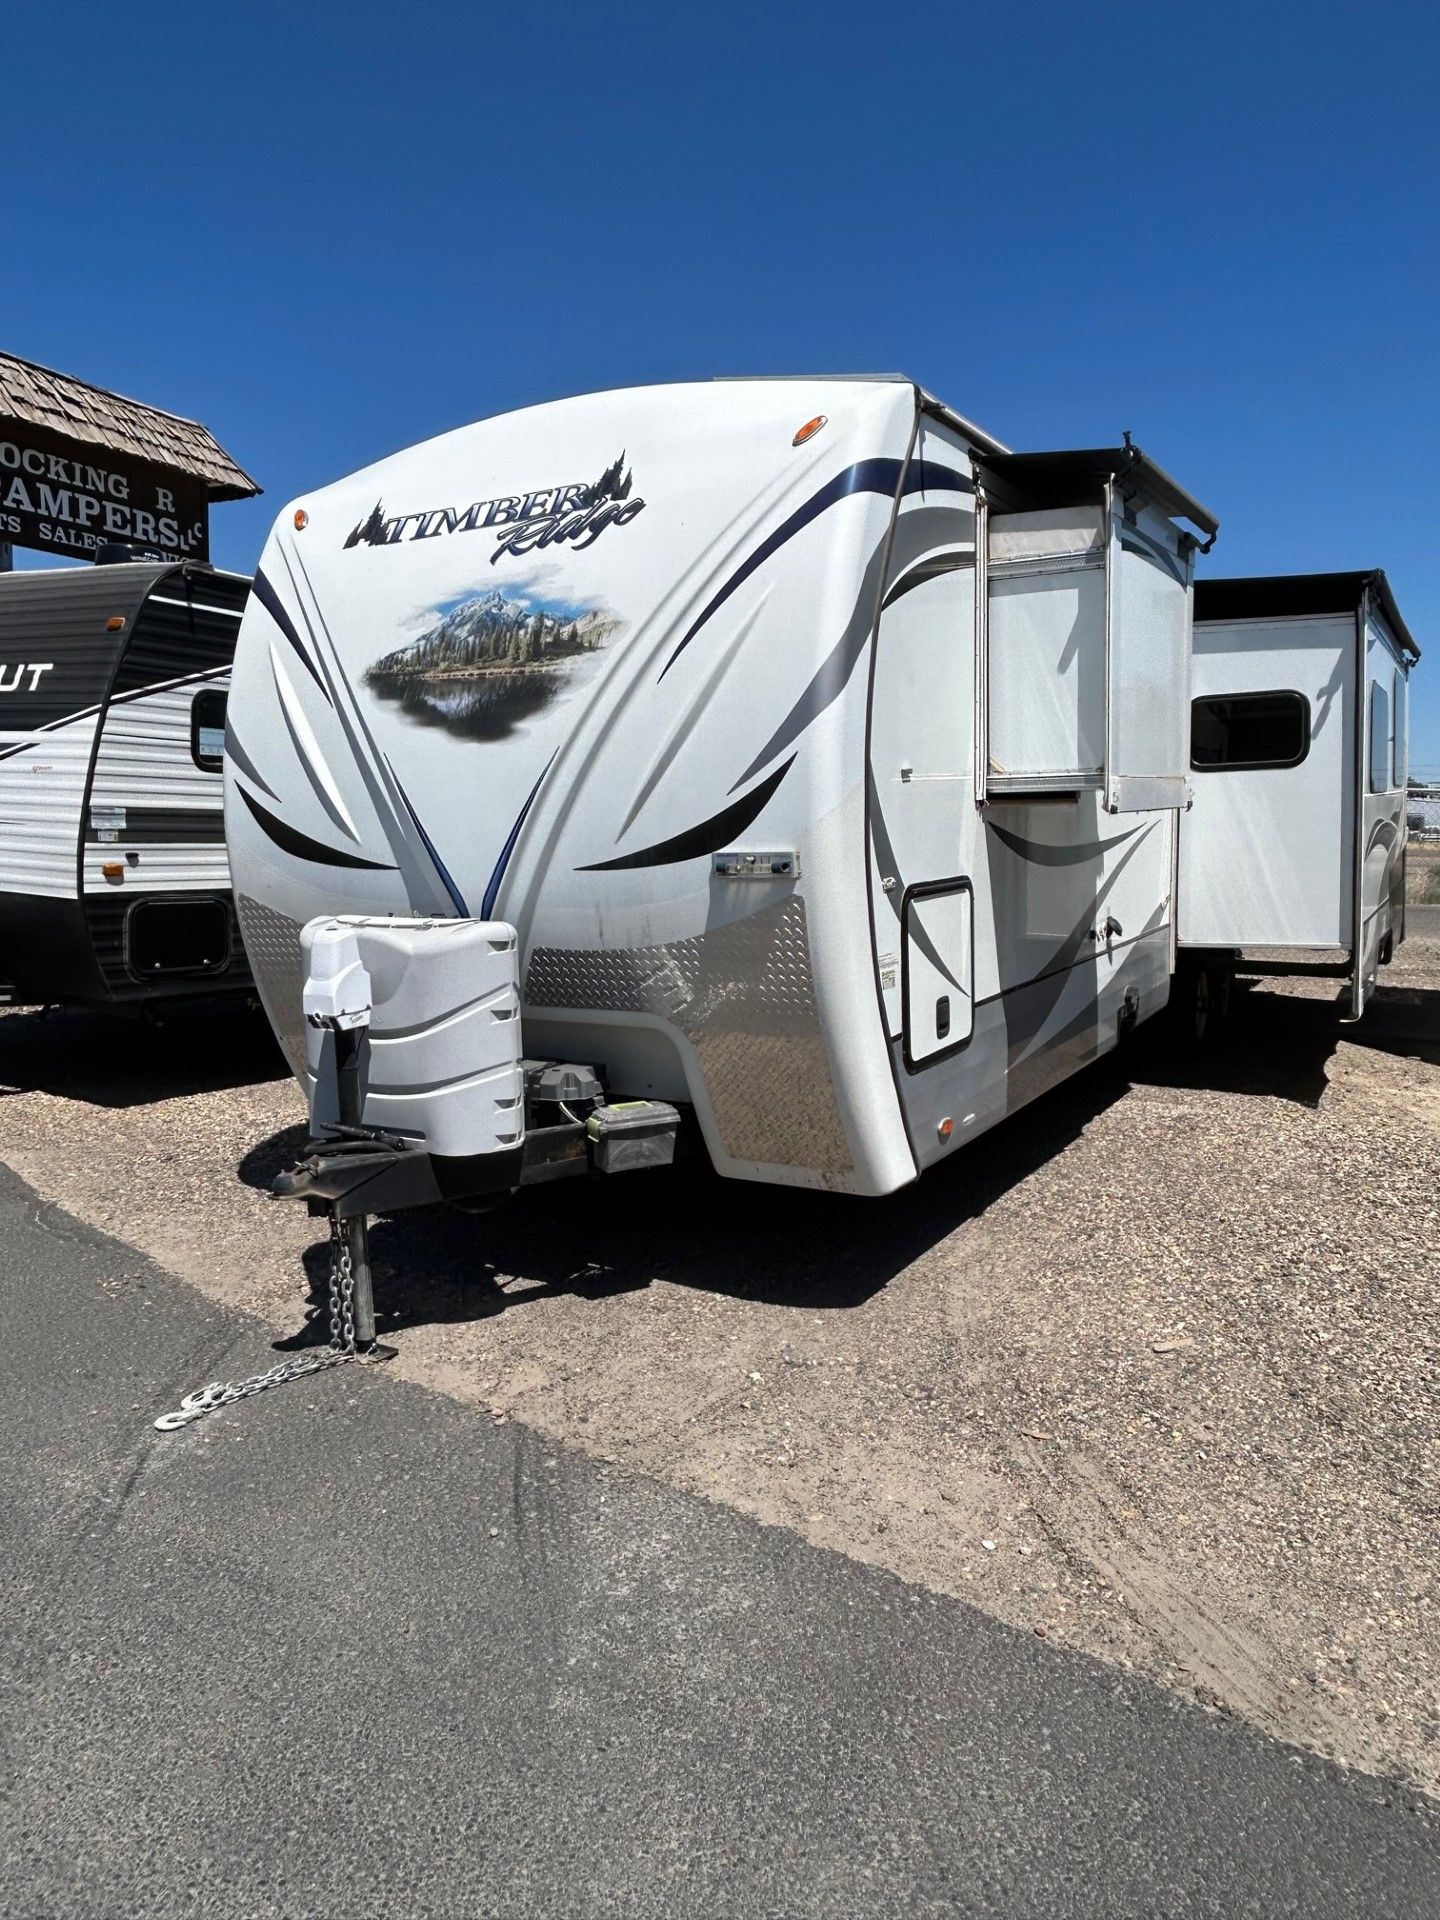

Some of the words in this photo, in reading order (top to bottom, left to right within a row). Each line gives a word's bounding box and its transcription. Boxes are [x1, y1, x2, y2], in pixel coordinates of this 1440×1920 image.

[0, 442, 129, 499] OCKING
[155, 486, 175, 513] R
[0, 476, 179, 547] AMPERS
[180, 522, 203, 551] LLC
[387, 483, 595, 544] TIMBER
[489, 497, 647, 565] Ridge
[0, 663, 54, 691] UT
